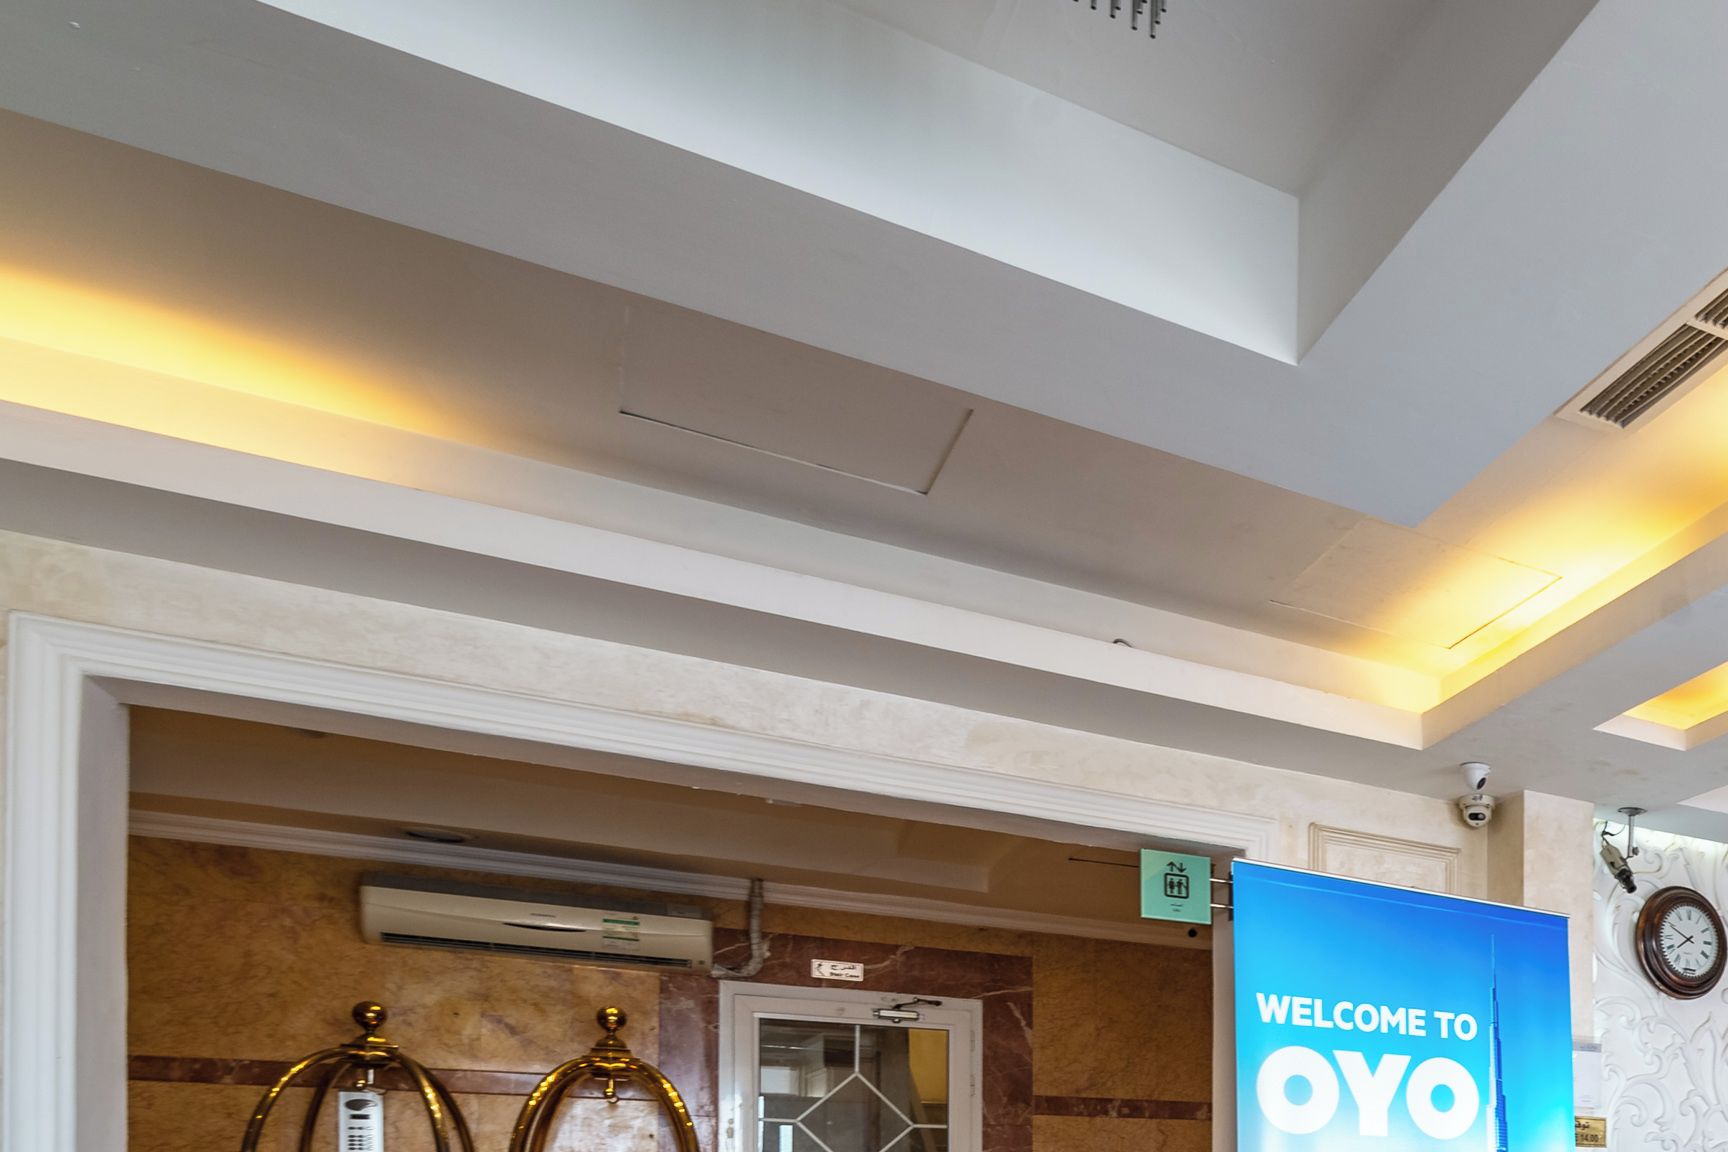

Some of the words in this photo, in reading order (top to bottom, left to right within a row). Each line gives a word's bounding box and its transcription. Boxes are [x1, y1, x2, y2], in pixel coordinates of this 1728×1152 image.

[1256, 992, 1426, 1037] WELCOME
[1434, 1011, 1478, 1041] TO
[1256, 1045, 1480, 1140] OYO
